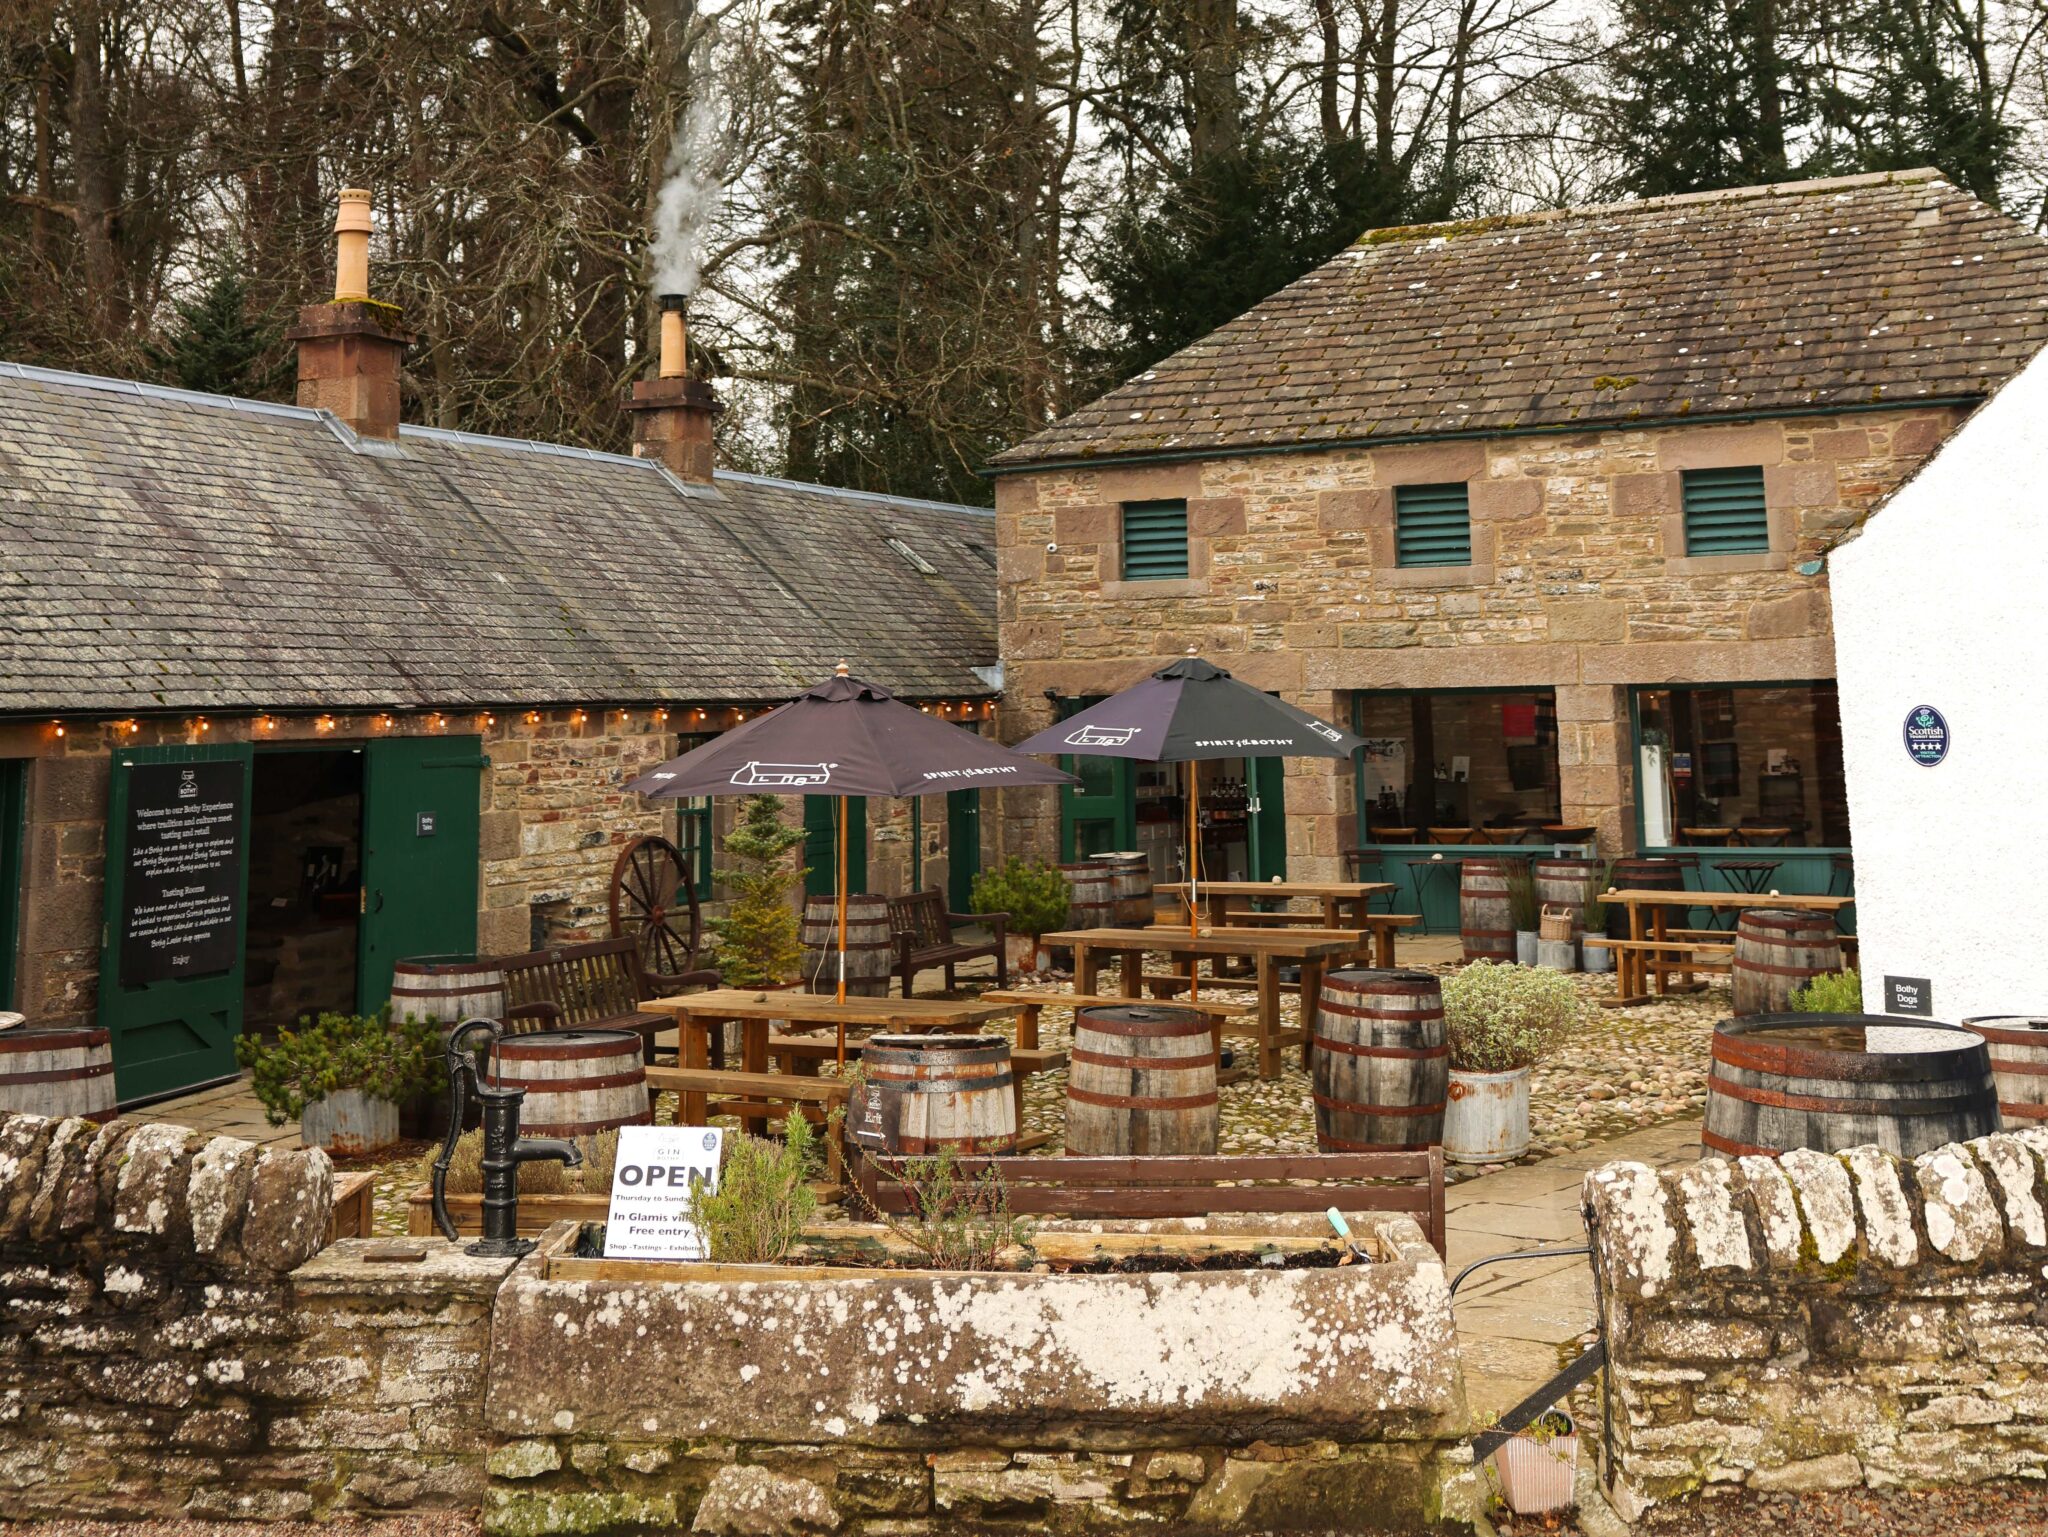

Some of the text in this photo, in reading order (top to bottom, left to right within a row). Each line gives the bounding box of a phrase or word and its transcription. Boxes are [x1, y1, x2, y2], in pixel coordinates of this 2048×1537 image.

[1908, 726, 1943, 735] Scottish
[1195, 739, 1234, 747] SPIRIT
[923, 770, 961, 779] SPIRIT
[974, 766, 1018, 775] BOTHY
[136, 801, 234, 818] Welcome to our Bothy Experience
[137, 814, 233, 831] where tradition and culture meet
[161, 825, 210, 840] tasting and retail
[132, 847, 144, 856] Like
[148, 845, 163, 856] Bothy
[187, 841, 195, 849] for
[195, 842, 204, 851] you
[209, 838, 225, 848] explore
[224, 836, 234, 845] and
[142, 857, 158, 868] Bothy
[157, 855, 184, 866] Beginnings
[183, 852, 194, 861] and
[194, 851, 209, 861] Bothy
[208, 849, 220, 858] Tales
[145, 867, 163, 878] explain
[162, 866, 176, 874] what
[179, 863, 194, 873] Bothy
[193, 862, 209, 870] means
[162, 885, 206, 898] Tasting Rooms
[134, 905, 143, 915] We
[143, 905, 155, 913] have
[167, 901, 178, 910] and
[178, 900, 195, 910] tasting
[207, 894, 220, 904] which
[131, 918, 139, 927] be
[138, 915, 156, 925] booked
[161, 912, 186, 923] experience
[185, 908, 204, 918] Scottish
[203, 906, 221, 918] produce
[220, 903, 231, 912] and
[137, 926, 159, 936] seasonal
[158, 925, 173, 933] events
[173, 920, 194, 931] calendar
[199, 917, 219, 926] available
[151, 938, 166, 949] Bothy
[182, 935, 193, 944] shop
[193, 931, 211, 943] opposite
[172, 955, 190, 965] Enjoy
[1895, 984, 1918, 995] Bothy
[1897, 993, 1918, 1005] Dogs
[619, 1165, 712, 1187] OPEN
[615, 1194, 651, 1202] Thursday
[614, 1212, 625, 1221] In
[628, 1212, 668, 1222] Glamis
[629, 1226, 690, 1238] Free entry
[609, 1243, 628, 1251] Shop
[633, 1244, 662, 1252] Tastings
